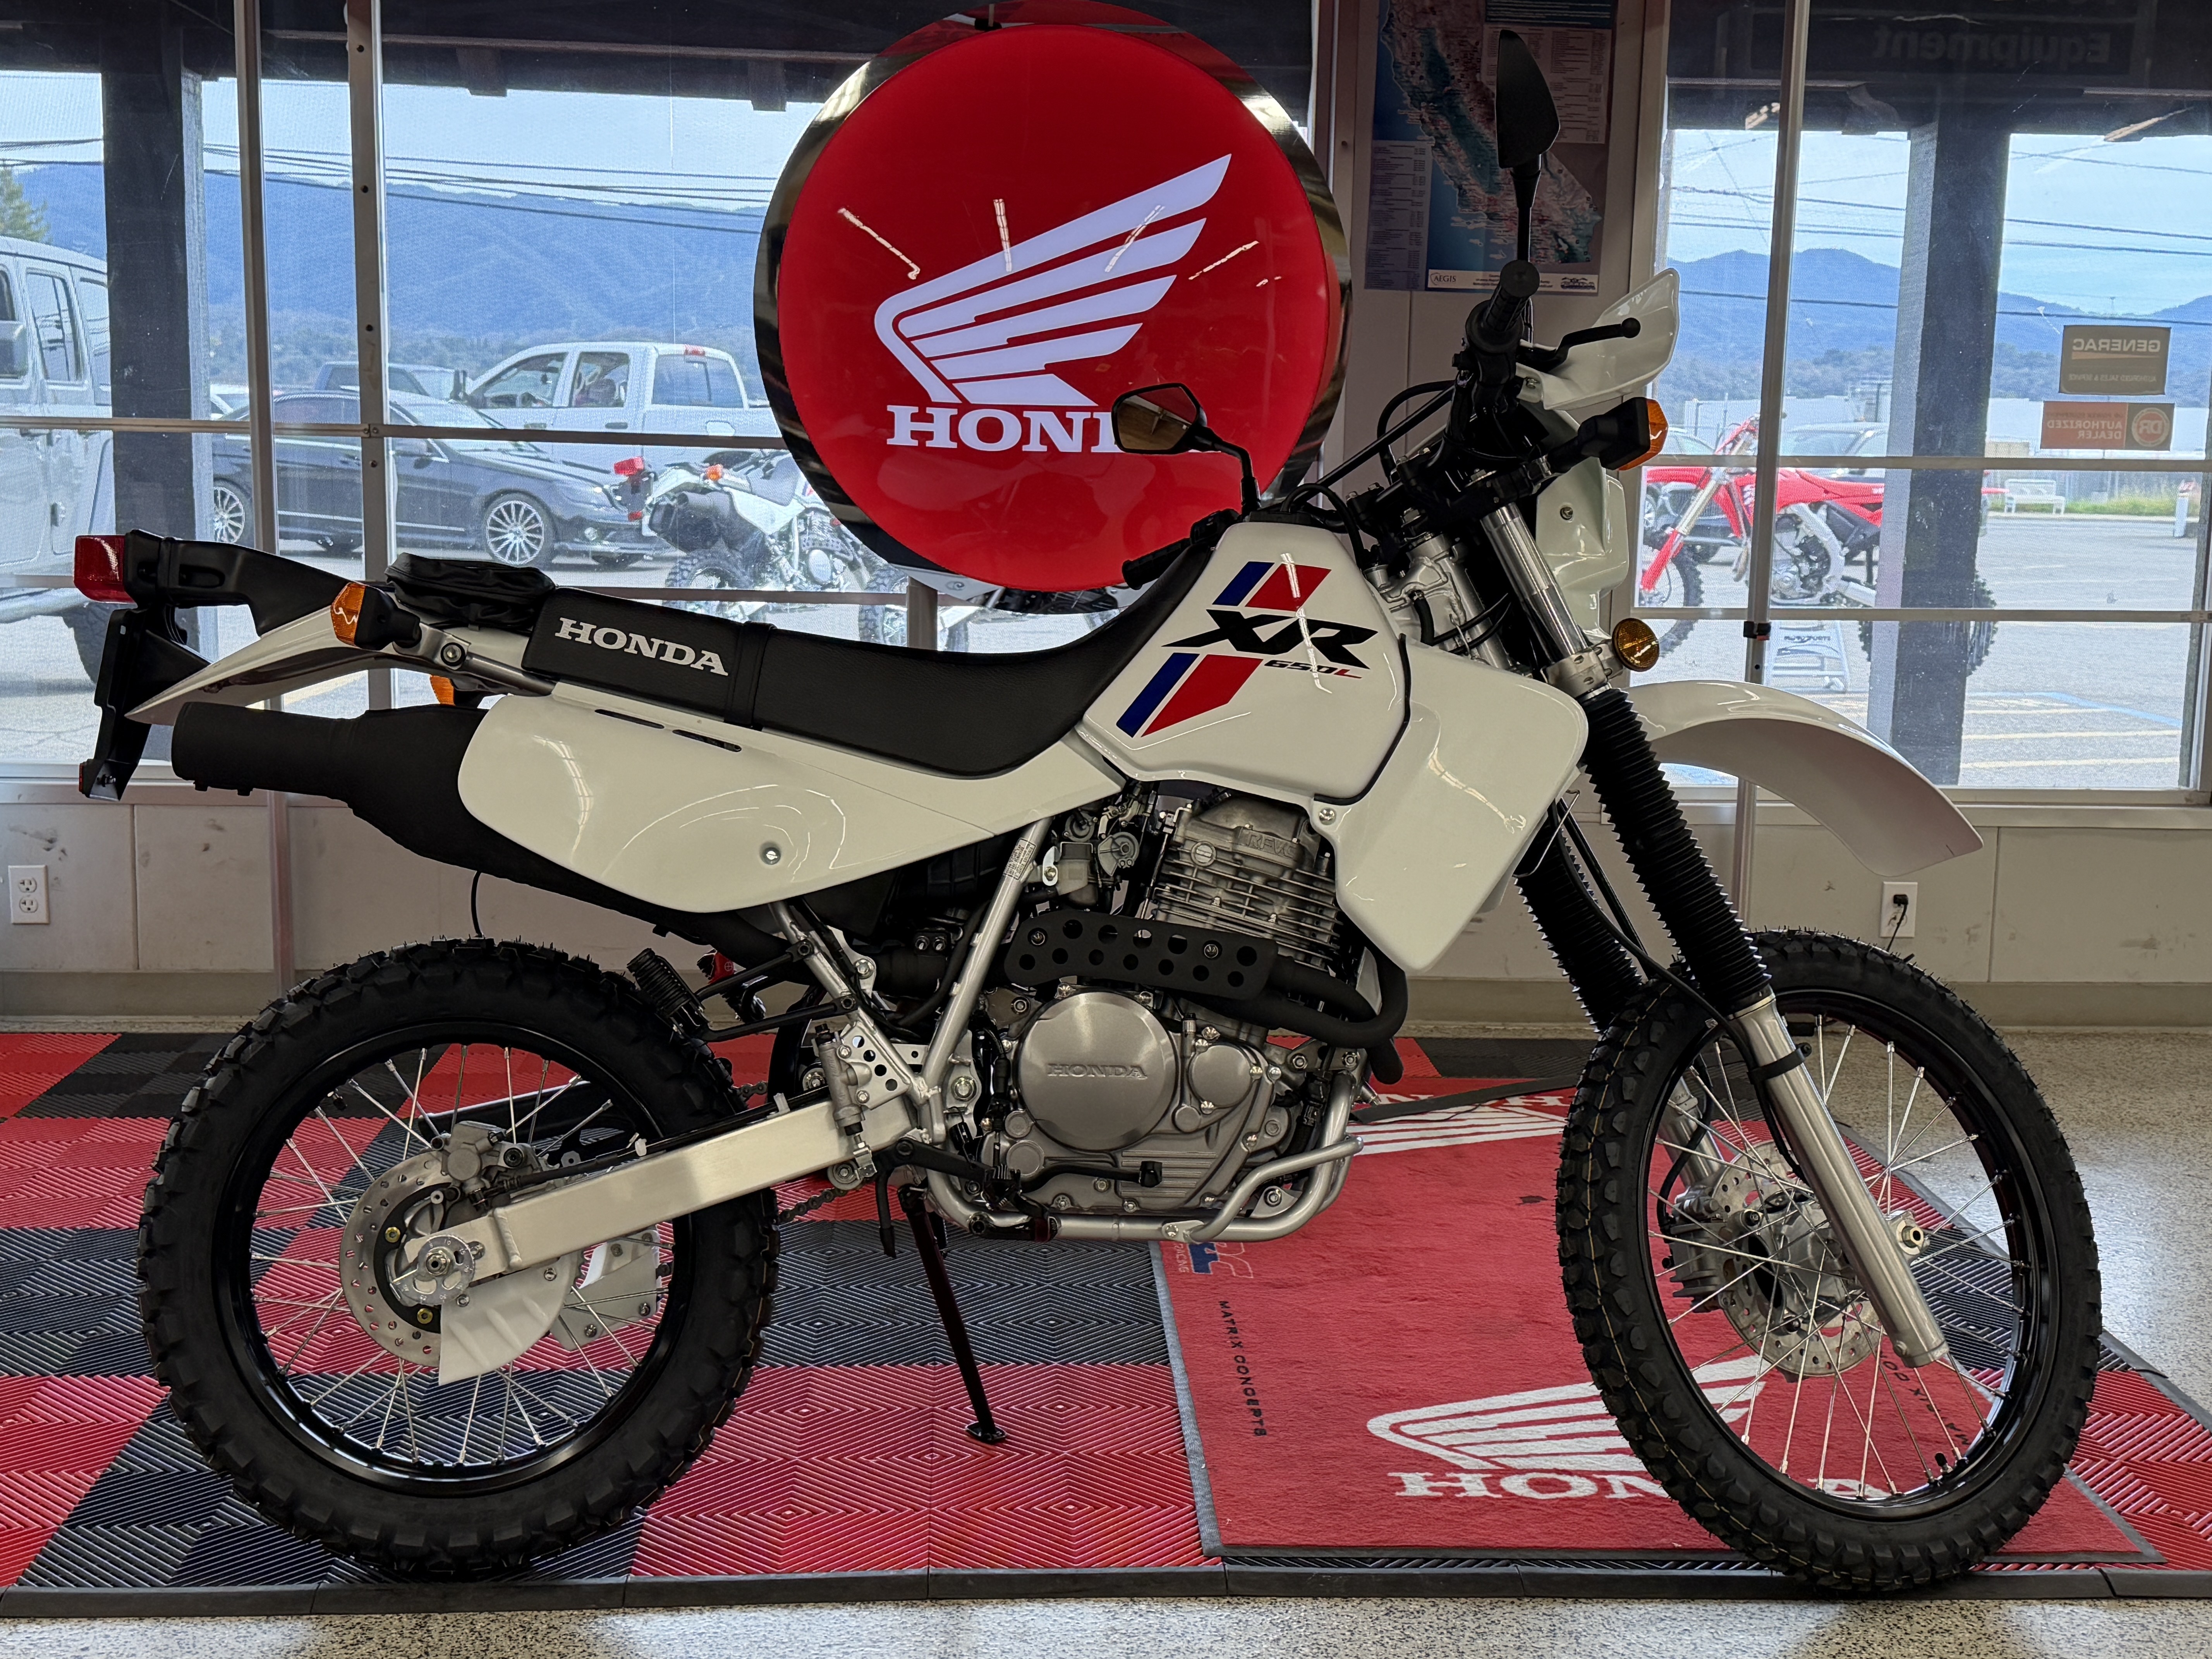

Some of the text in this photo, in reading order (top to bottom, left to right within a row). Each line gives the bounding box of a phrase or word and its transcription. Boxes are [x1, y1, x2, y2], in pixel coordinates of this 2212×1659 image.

[887, 405, 1126, 453] HON
[555, 617, 728, 676] HONDA
[1161, 609, 1378, 670] XR
[1264, 659, 1362, 679] 650L
[1047, 1063, 1148, 1080] HONDA
[1218, 1300, 1243, 1349] MATRIX
[1234, 1354, 1268, 1437] CONCEPTS
